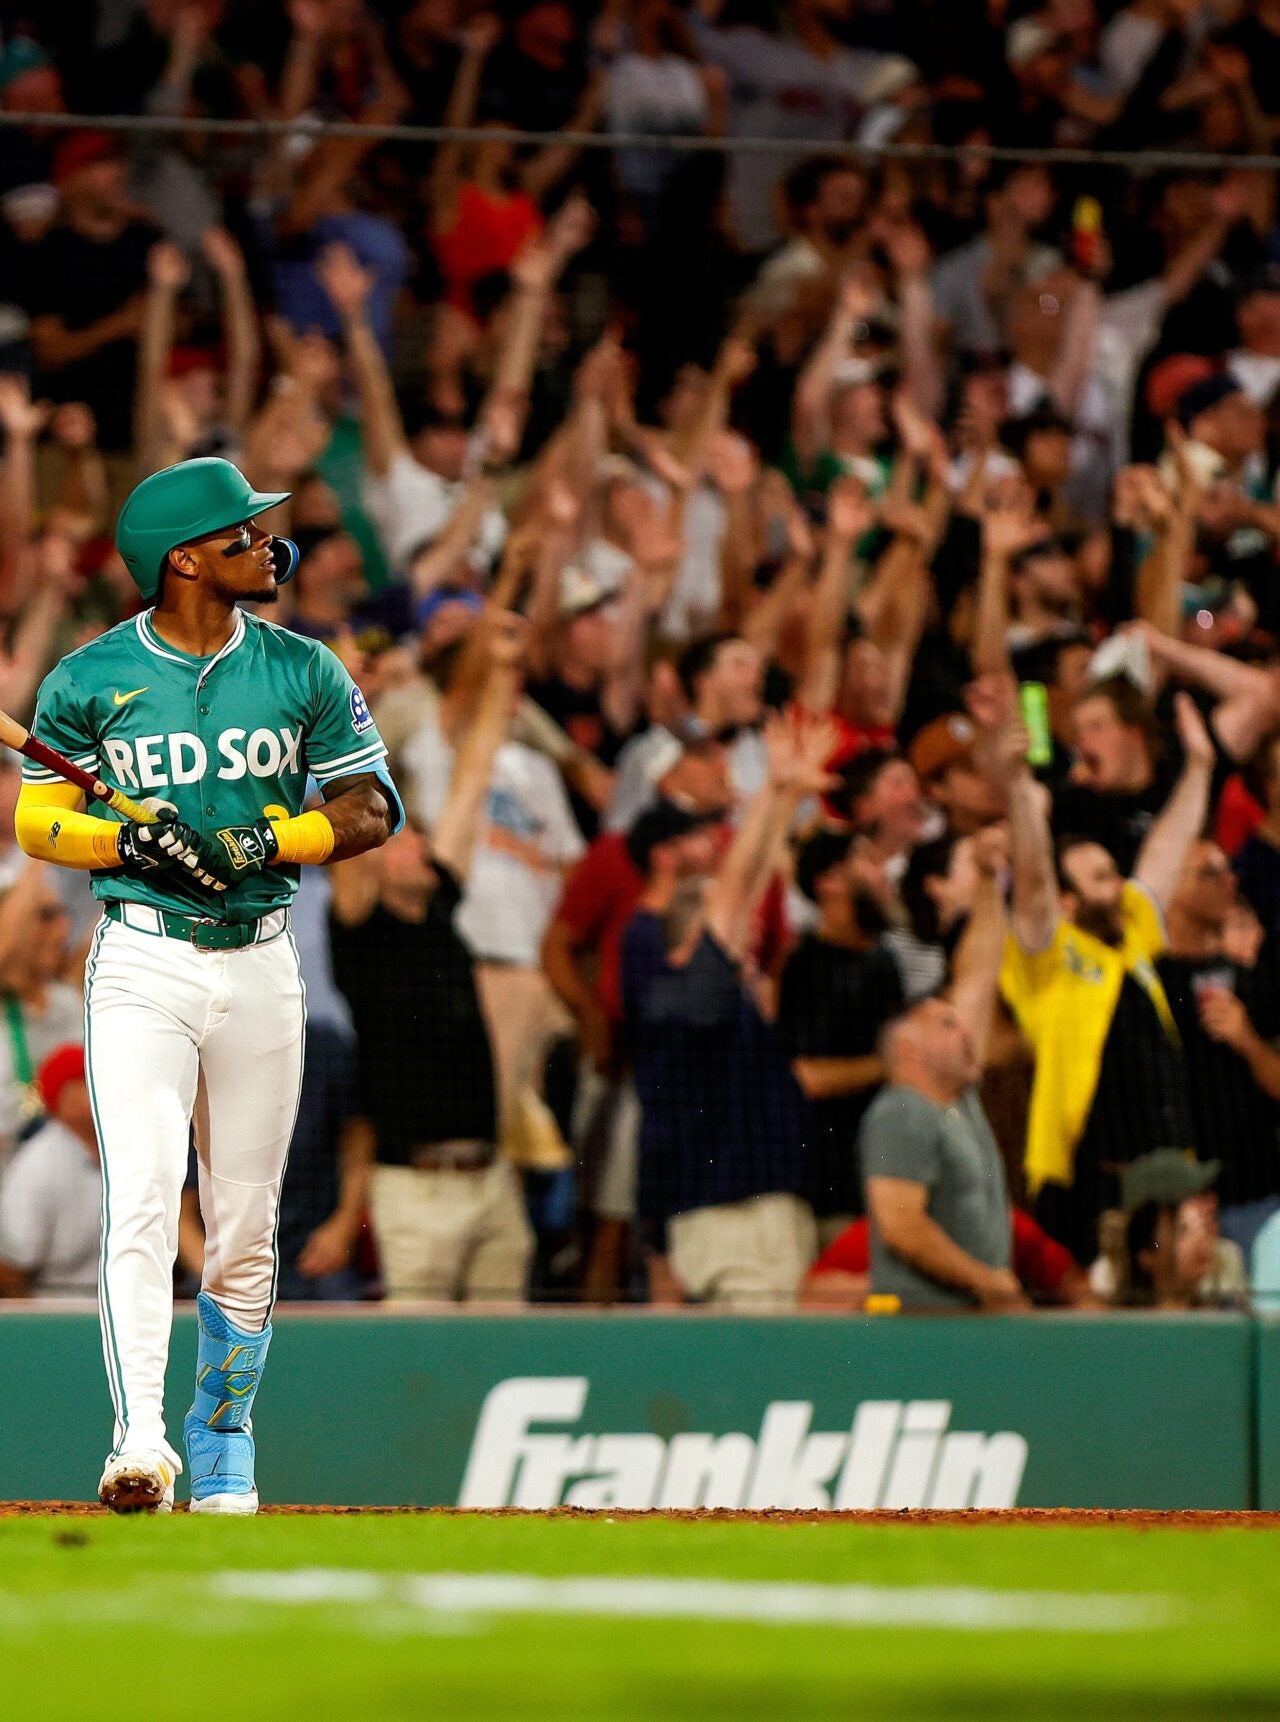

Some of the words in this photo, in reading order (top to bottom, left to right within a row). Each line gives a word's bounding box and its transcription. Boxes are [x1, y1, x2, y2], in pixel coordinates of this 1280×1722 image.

[102, 731, 208, 789] RED
[217, 725, 303, 780] SOX
[457, 1376, 1028, 1509] Franklin
